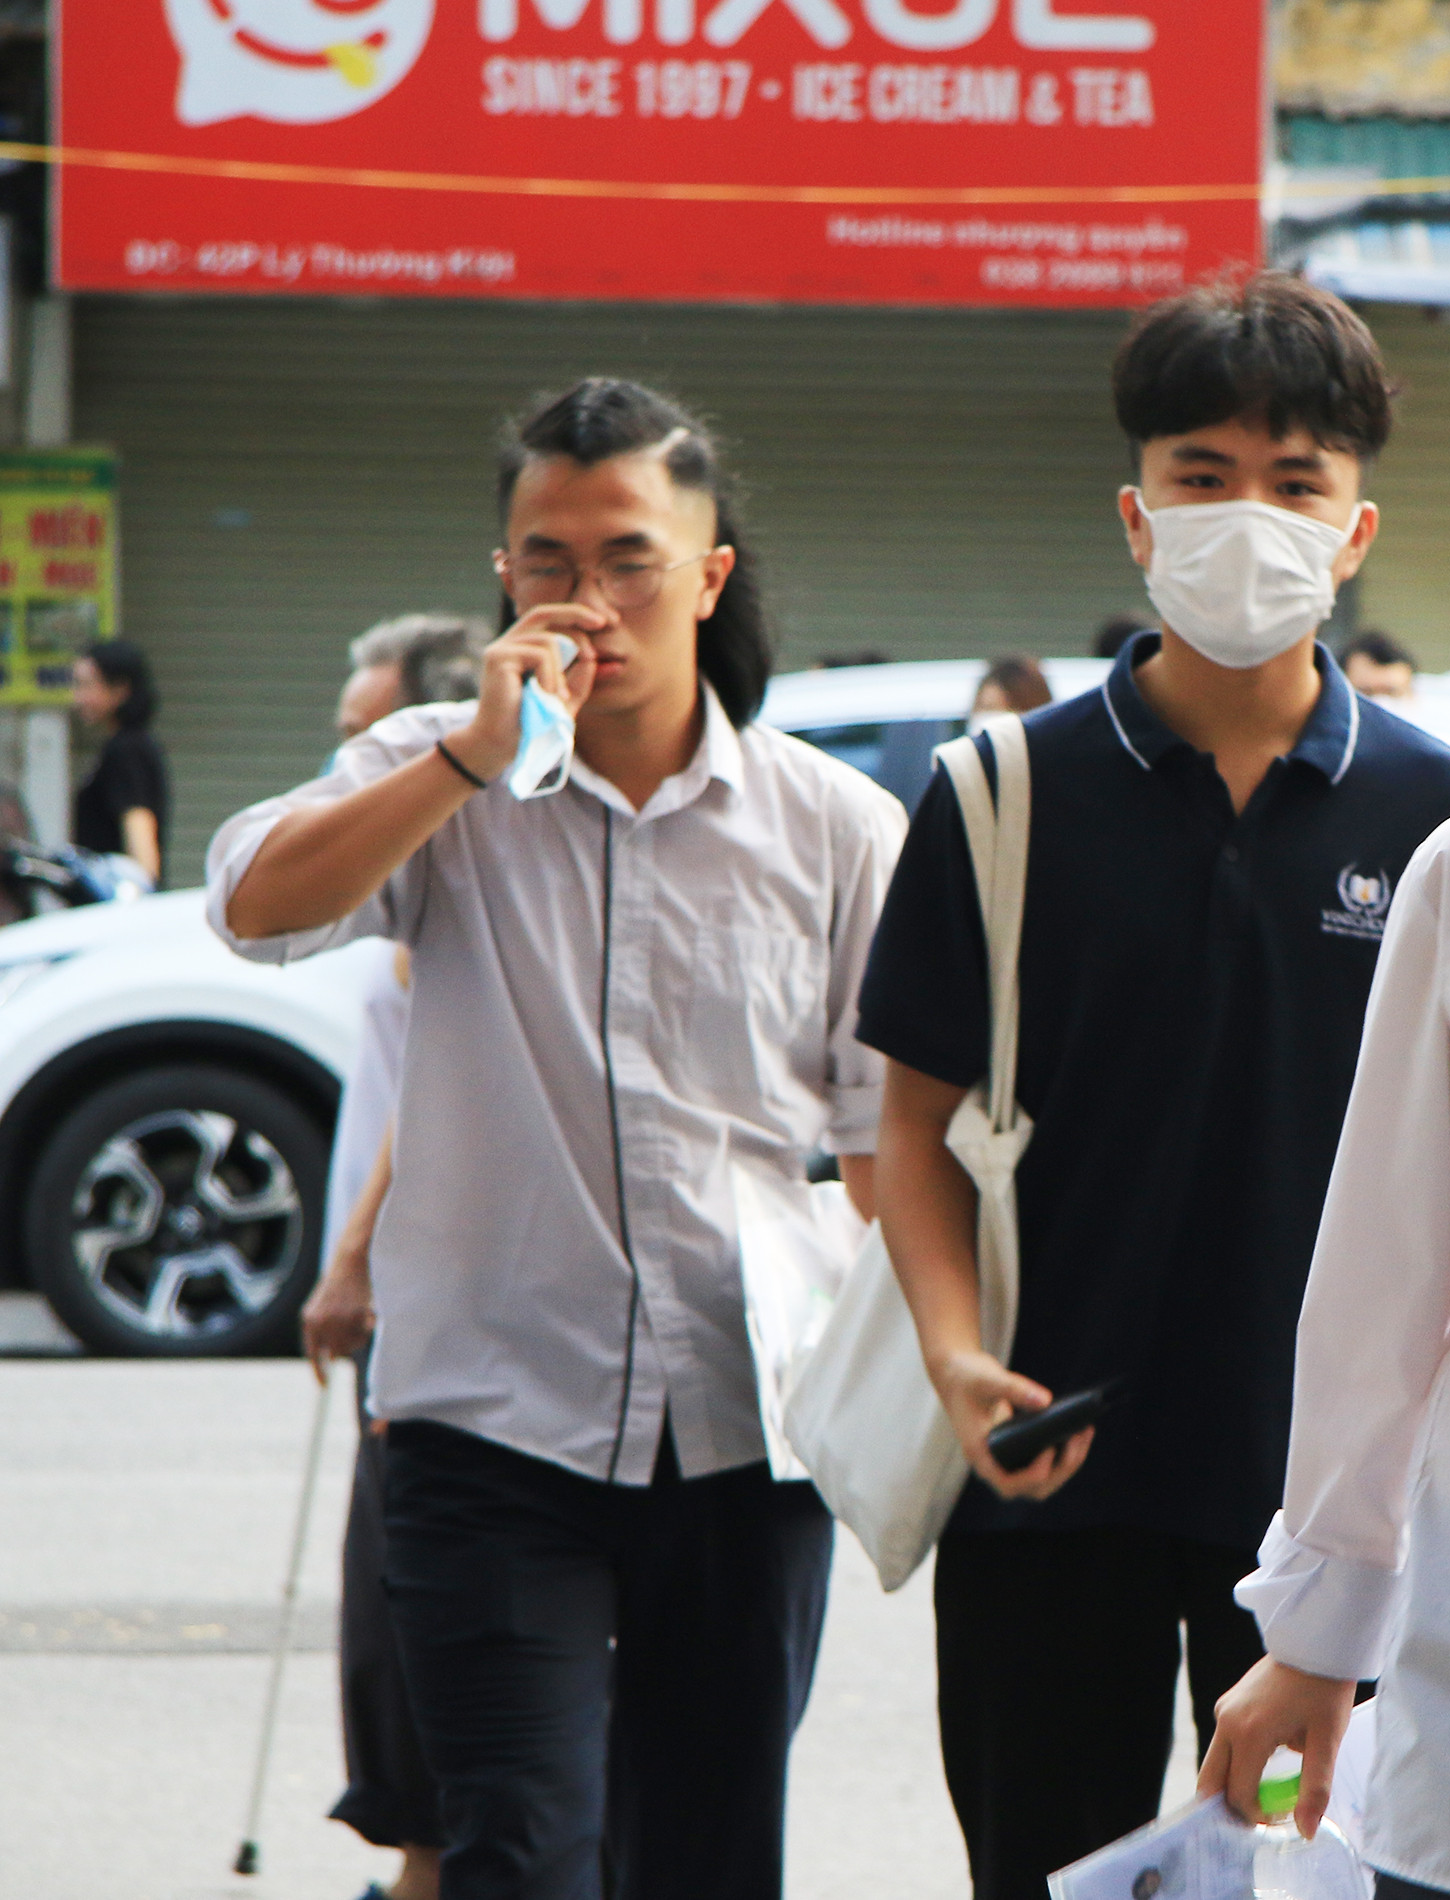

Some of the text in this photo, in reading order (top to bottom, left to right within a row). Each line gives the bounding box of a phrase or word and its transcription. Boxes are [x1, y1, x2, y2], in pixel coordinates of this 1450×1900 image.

[481, 56, 621, 118] SINCE
[635, 59, 752, 120] 1997
[792, 62, 863, 123] ICE
[868, 63, 1021, 124] CREAM
[1026, 70, 1063, 126] &
[1067, 67, 1155, 128] TEA
[828, 215, 944, 247] Hotline
